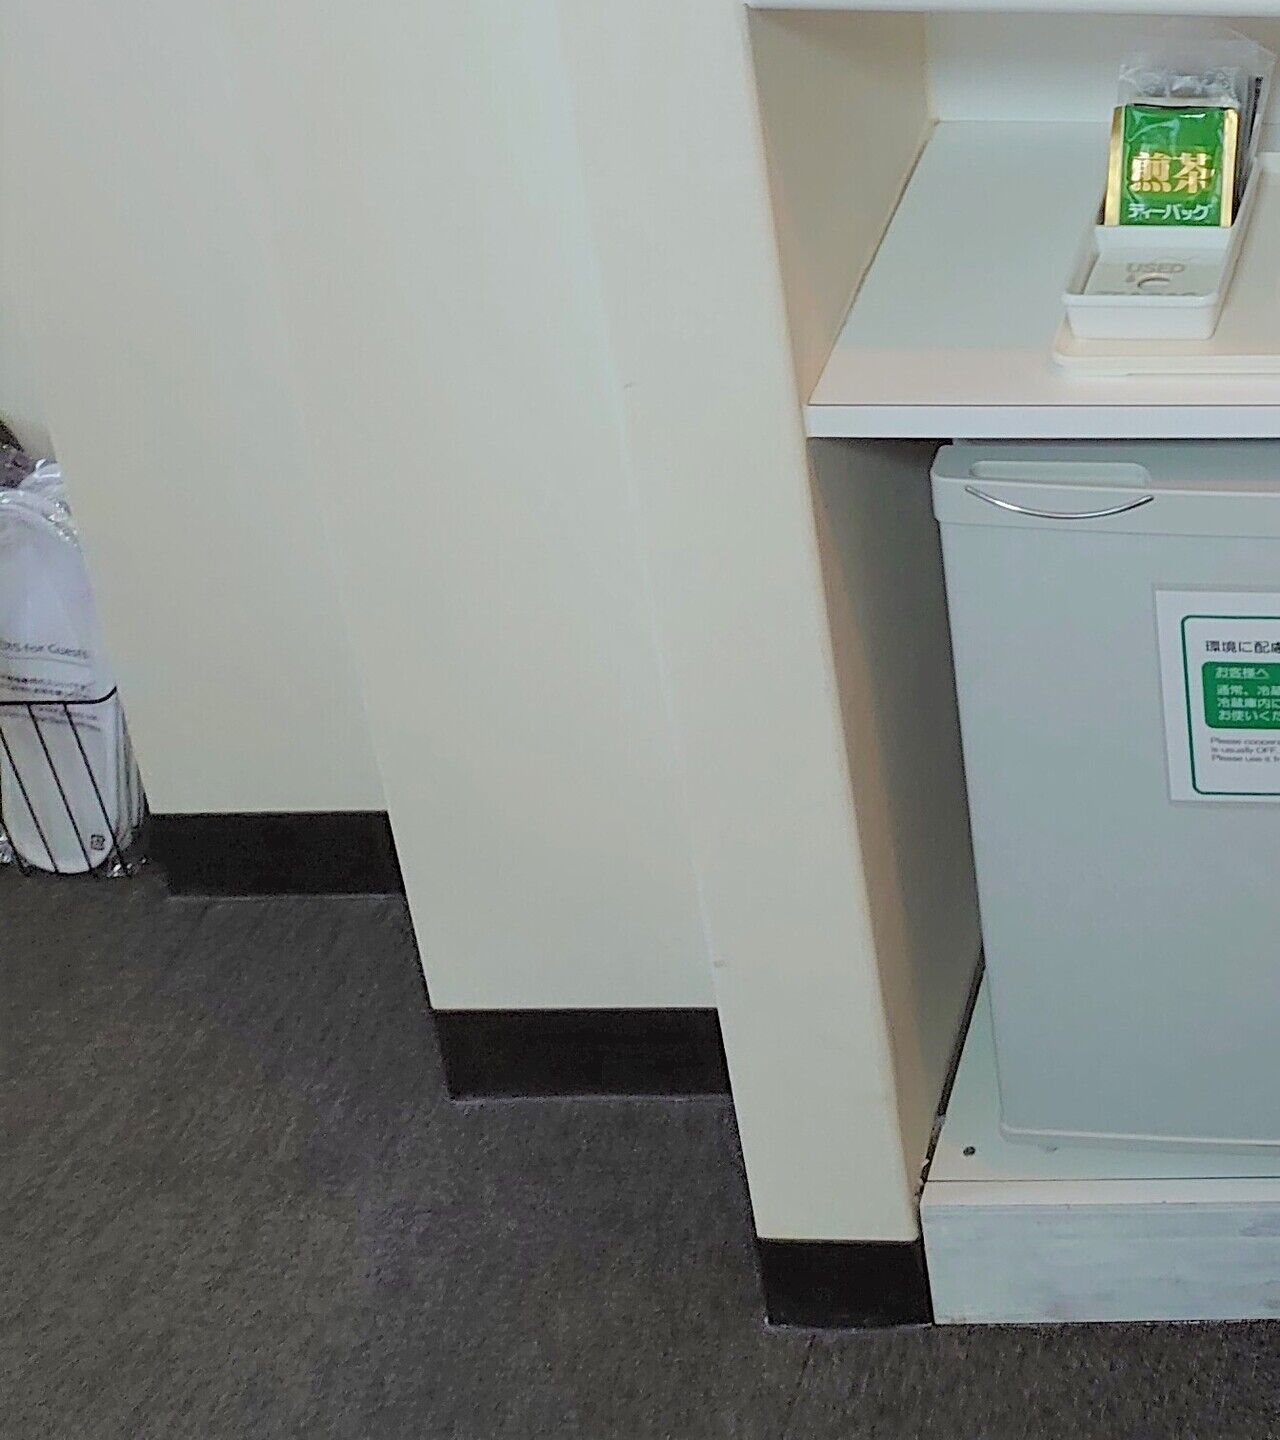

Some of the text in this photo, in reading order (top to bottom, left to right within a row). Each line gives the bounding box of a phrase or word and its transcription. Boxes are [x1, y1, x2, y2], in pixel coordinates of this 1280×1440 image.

[1130, 150, 1216, 194] 煎茶
[1127, 202, 1216, 221] ティーバッグ
[1215, 667, 1270, 680] お客様へ
